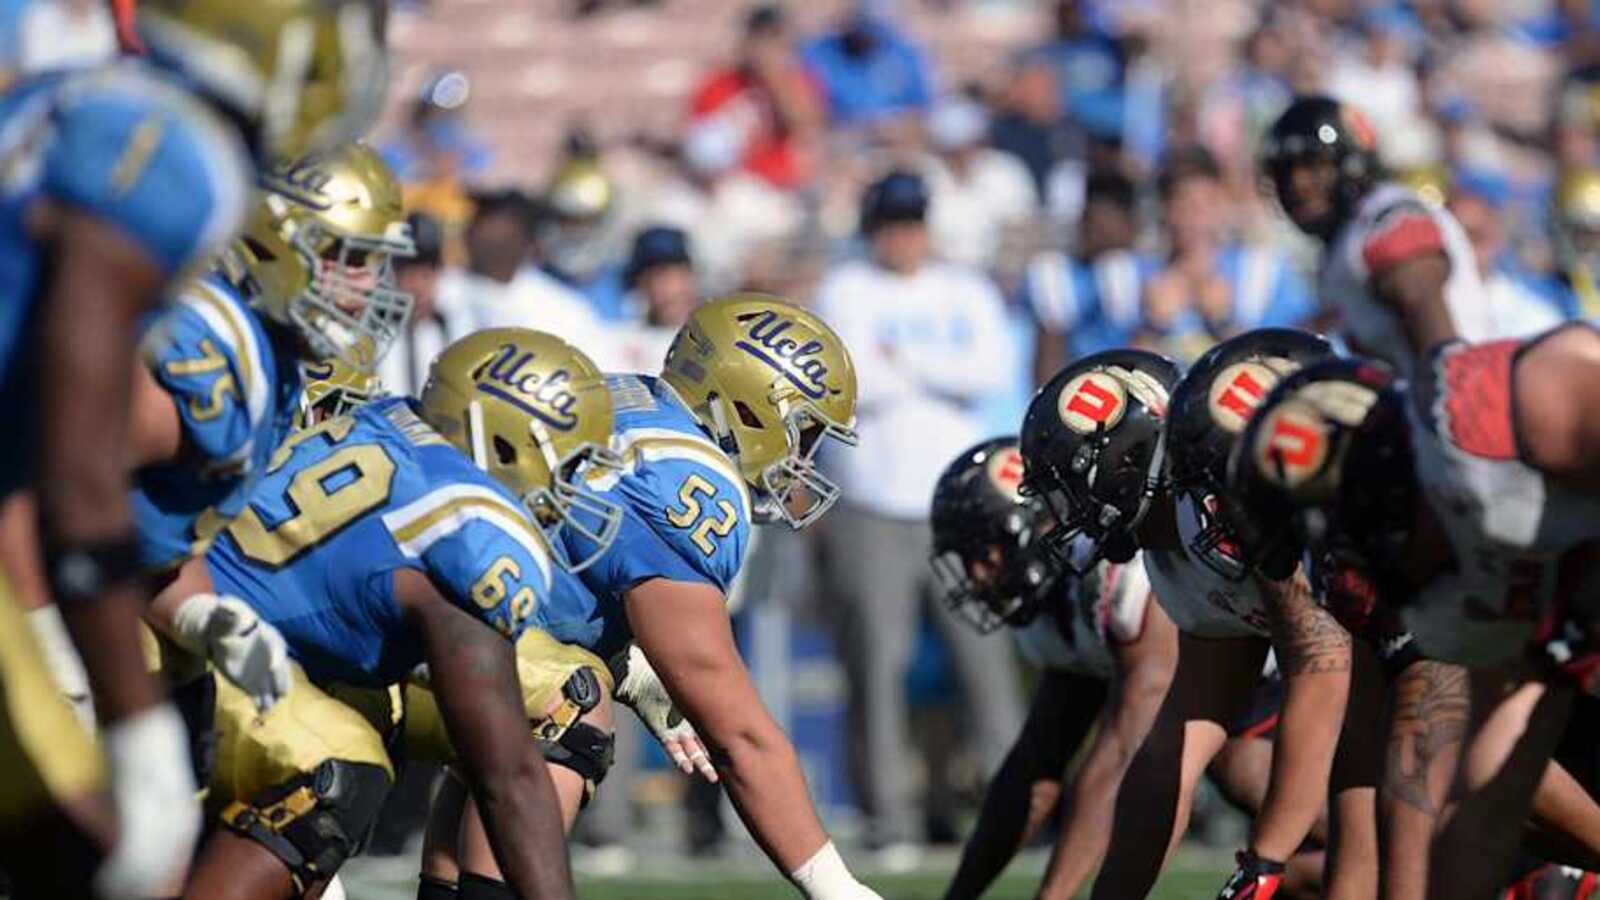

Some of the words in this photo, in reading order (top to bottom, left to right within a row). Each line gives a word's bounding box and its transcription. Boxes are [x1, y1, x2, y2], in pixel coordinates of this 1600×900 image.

[165, 338, 239, 421] 75
[474, 343, 578, 431] Ucla
[738, 310, 827, 399] Ucla
[1066, 379, 1121, 422] U
[1265, 417, 1321, 466] U
[664, 472, 739, 558] 52
[470, 554, 536, 638] 69
